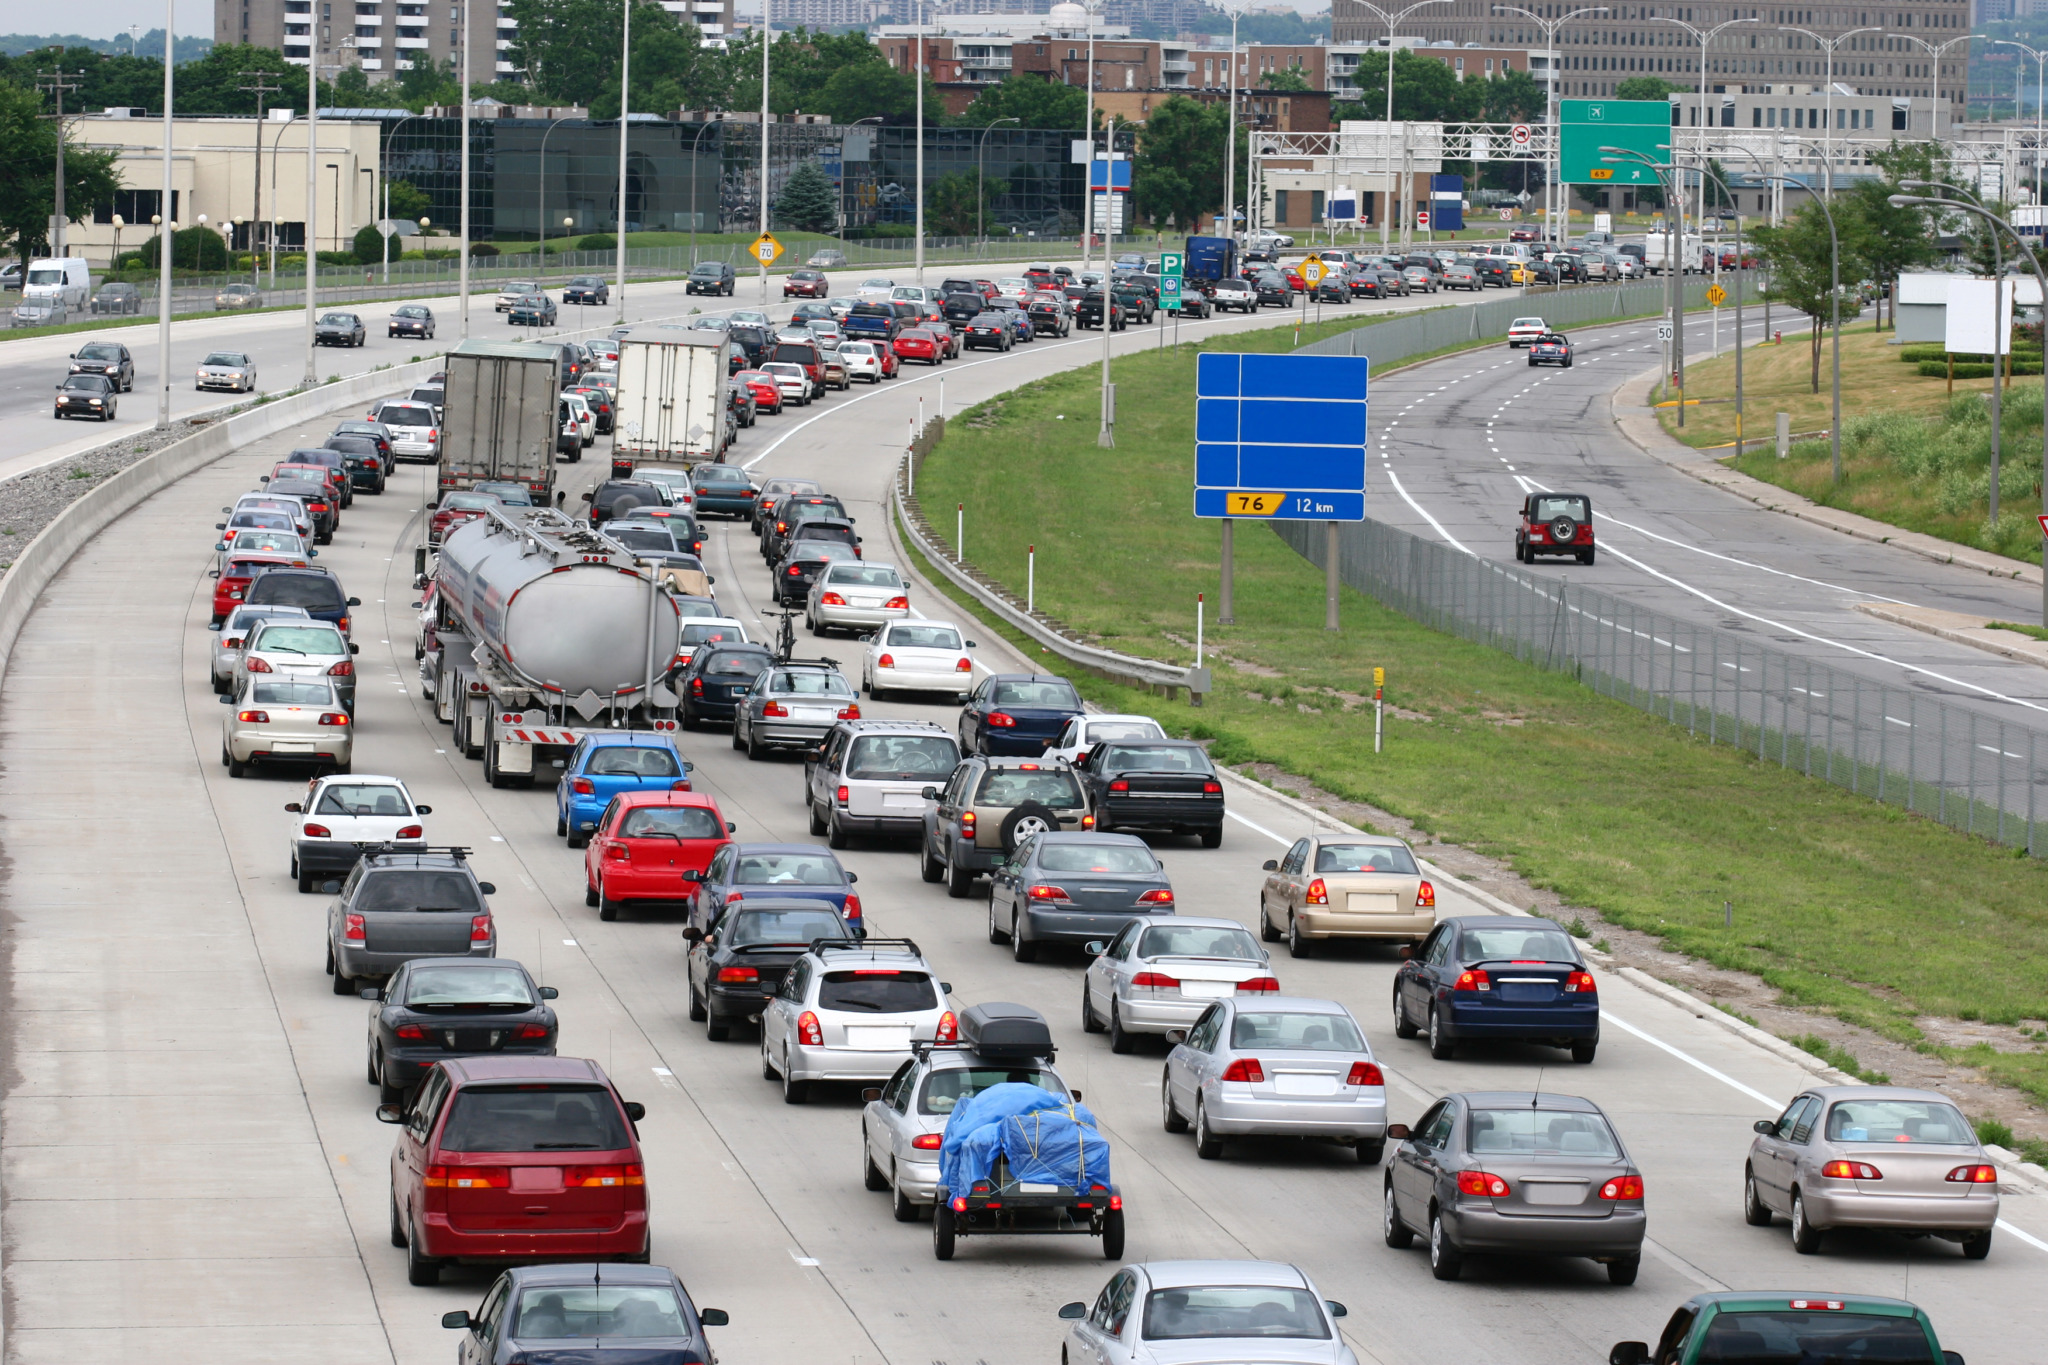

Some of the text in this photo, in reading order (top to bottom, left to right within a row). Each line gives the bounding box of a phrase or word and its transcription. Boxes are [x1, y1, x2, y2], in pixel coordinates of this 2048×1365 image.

[761, 248, 772, 257] 70
[1164, 255, 1178, 272] P
[1308, 269, 1318, 278] 70
[1659, 327, 1672, 338] 50
[1239, 497, 1334, 513] 76 12 km
